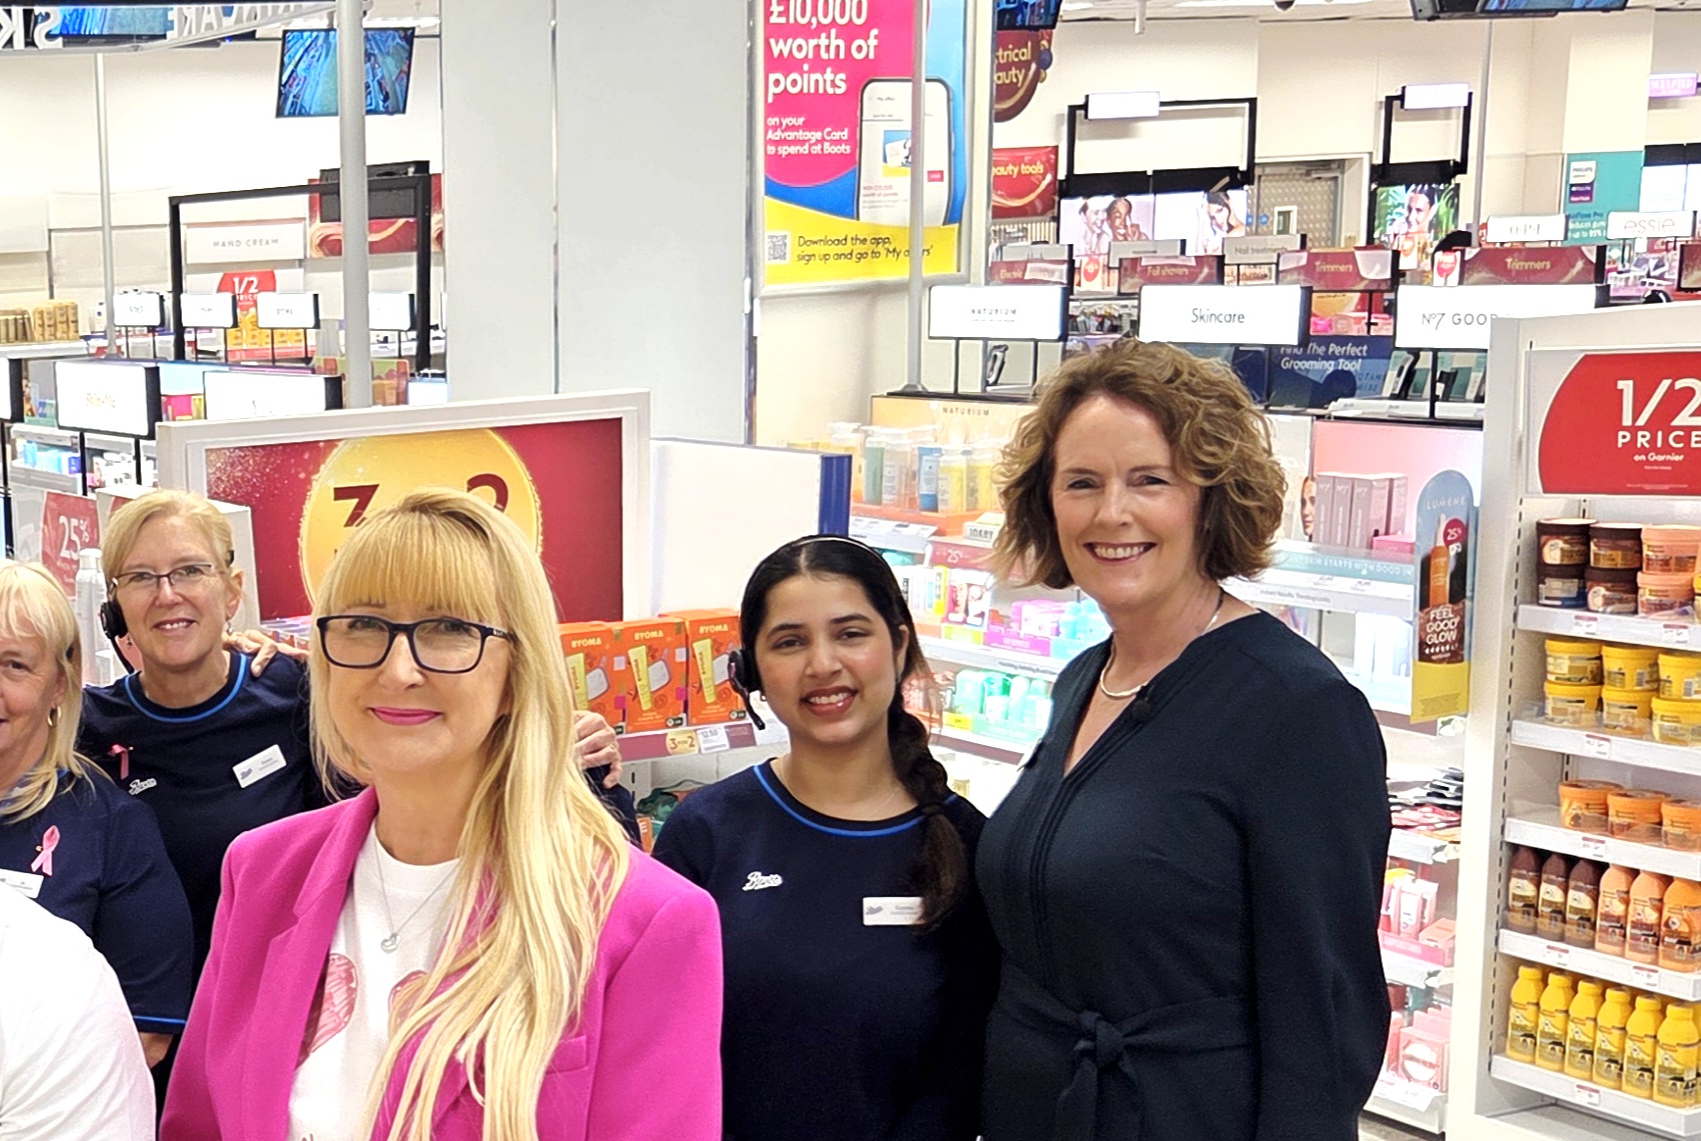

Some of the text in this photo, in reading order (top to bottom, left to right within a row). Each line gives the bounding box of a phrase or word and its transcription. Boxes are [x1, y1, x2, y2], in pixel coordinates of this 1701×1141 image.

[769, 0, 868, 29] £10,000
[769, 28, 879, 60] worth of
[767, 63, 847, 103] points
[767, 117, 805, 129] on your
[766, 127, 849, 143] Advantage Card
[767, 142, 851, 158] to spend at Boots
[1624, 219, 1675, 233] essie
[246, 238, 279, 246] CREAM
[798, 234, 892, 248] Download the app,
[797, 251, 816, 264] sign
[818, 253, 830, 263] up
[834, 248, 853, 260] and
[855, 251, 867, 263] go
[870, 249, 880, 259] to
[1505, 256, 1551, 270] Trimmers
[1314, 262, 1353, 273] Trimmers
[233, 277, 259, 295] 1/2
[1191, 308, 1246, 323] Skincare
[1328, 343, 1368, 356] Perfect
[1280, 357, 1362, 373] Grooming Tool
[1616, 378, 1701, 426] 1/2
[1617, 431, 1701, 448] PRICE
[1633, 452, 1685, 462] on Garnier
[1430, 607, 1453, 619] FEEL
[1426, 617, 1460, 633] GOOD
[1426, 629, 1458, 645] GLOW
